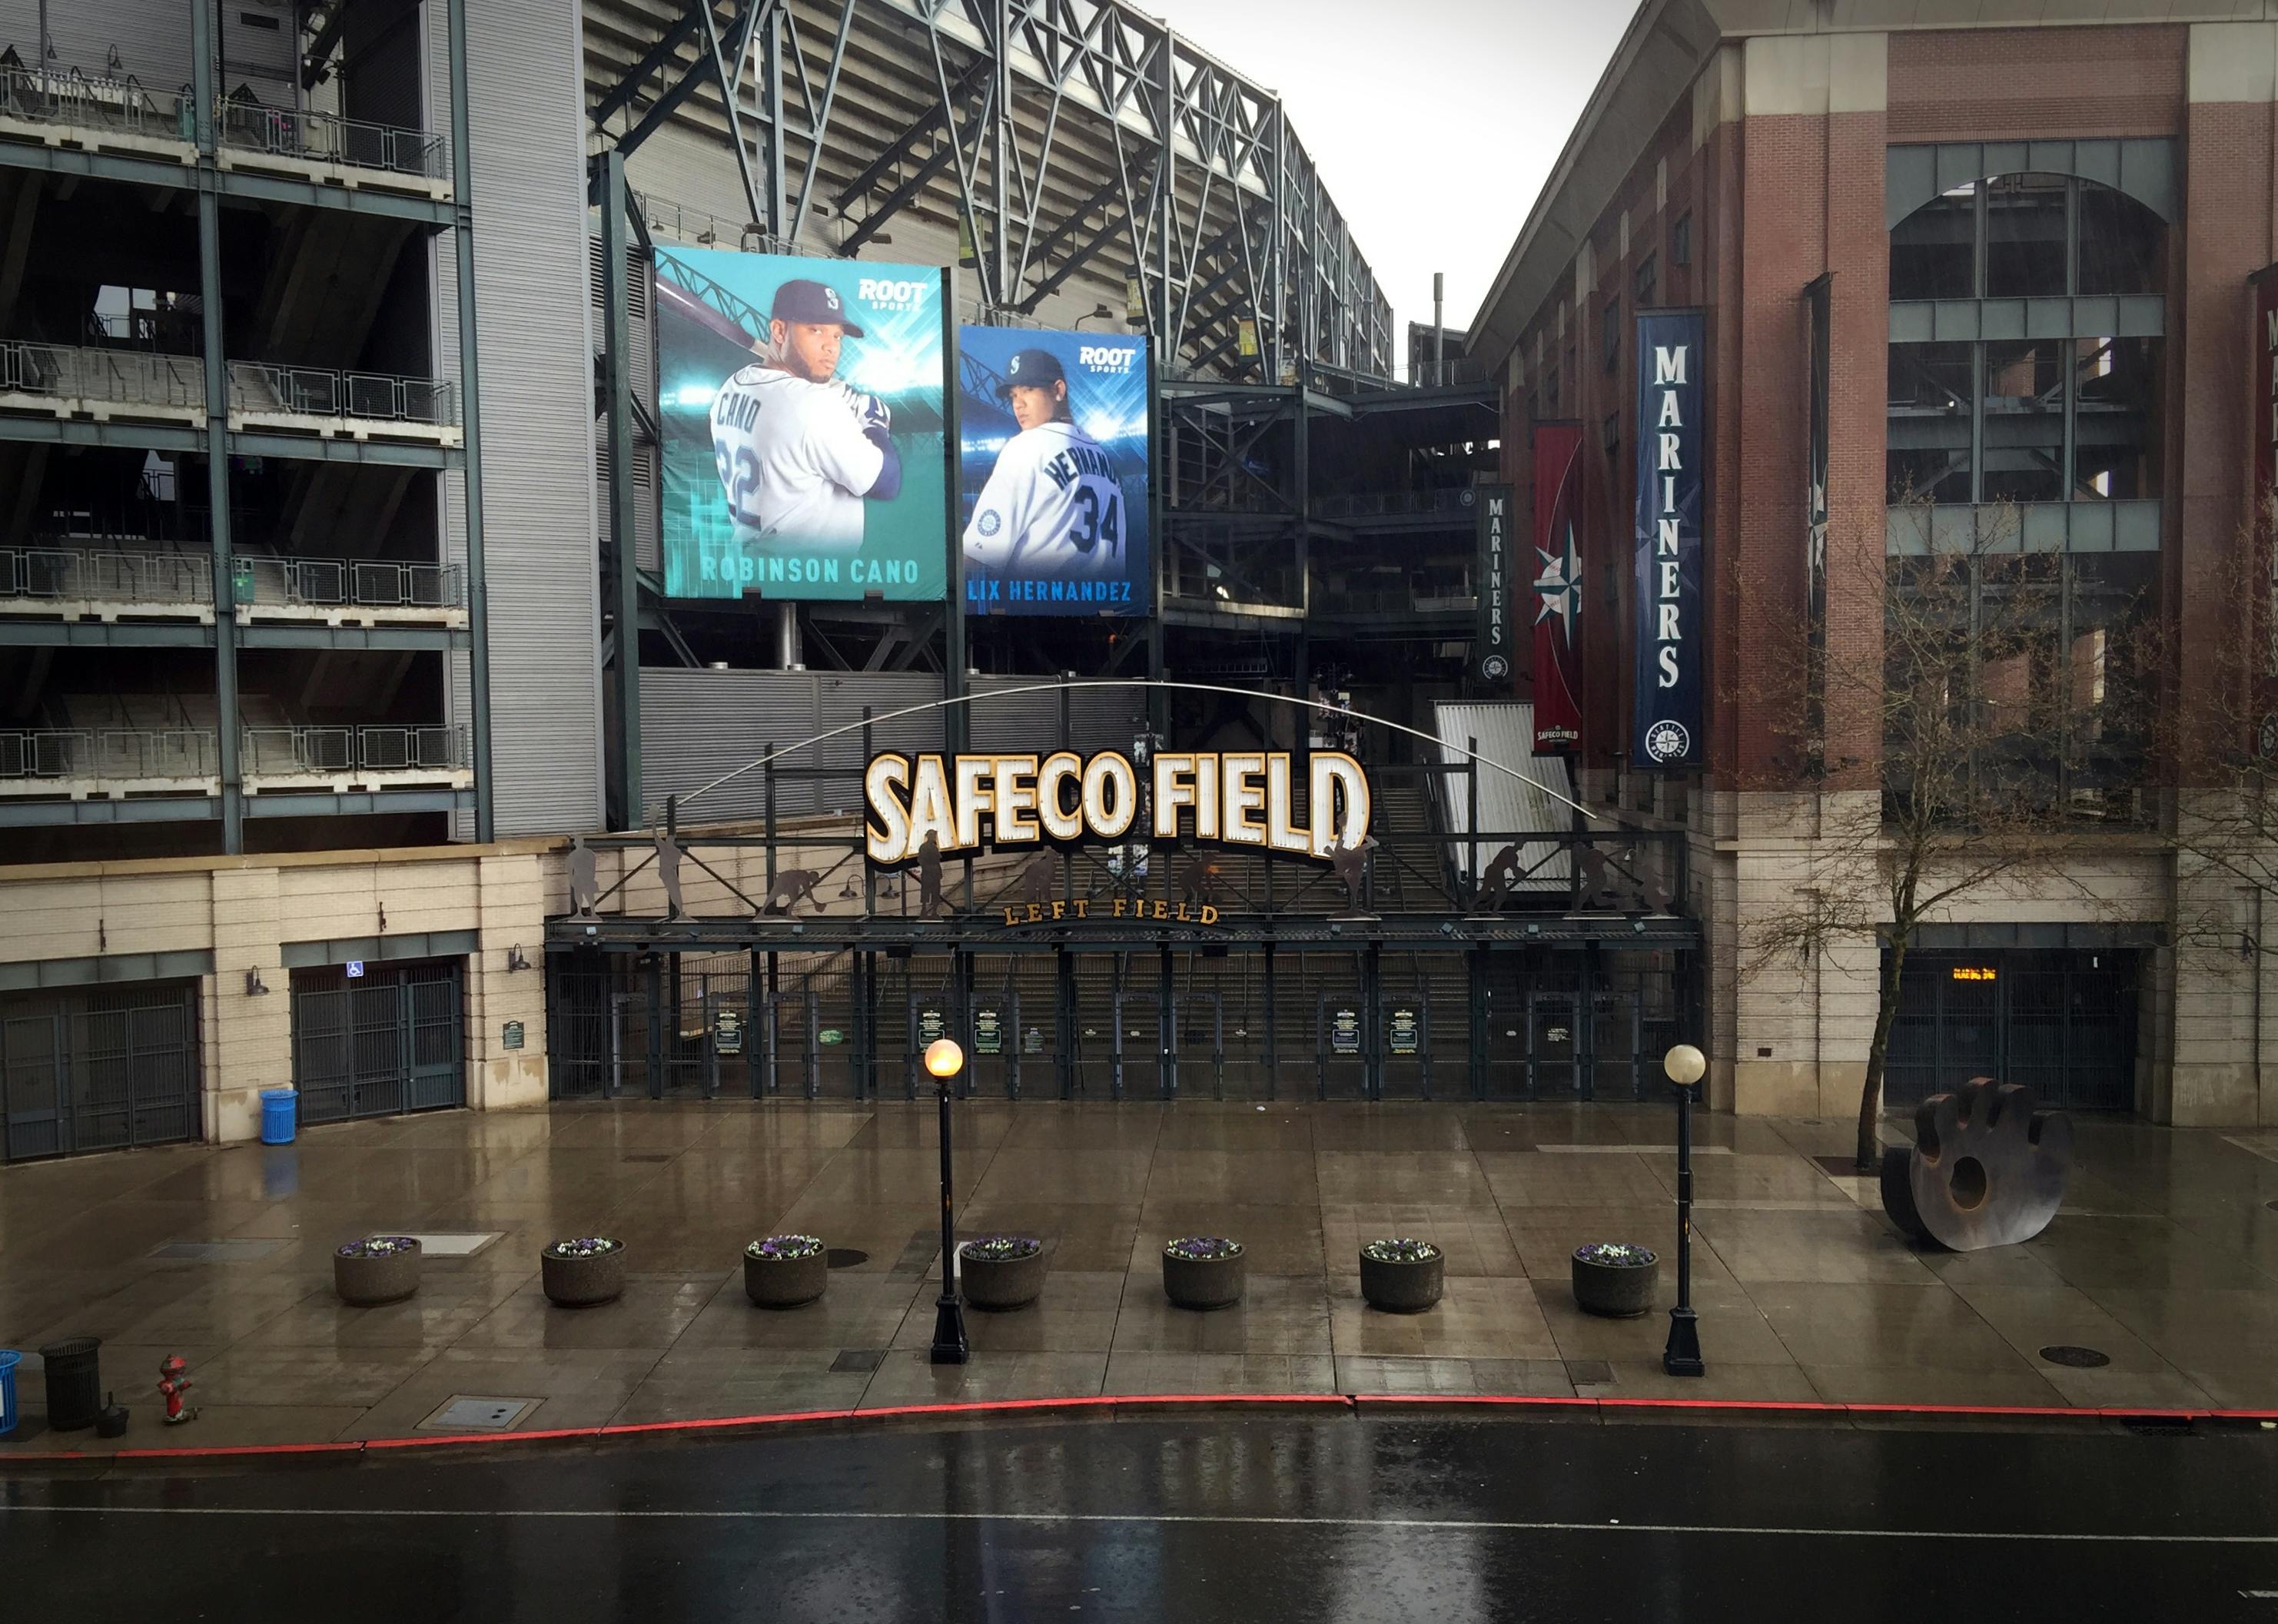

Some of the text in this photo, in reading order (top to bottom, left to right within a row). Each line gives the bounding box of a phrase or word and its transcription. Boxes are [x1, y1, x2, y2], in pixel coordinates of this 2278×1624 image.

[858, 278, 928, 303] ROOT
[1079, 346, 1136, 367] ROOT
[1090, 365, 1130, 374] SPORTS
[716, 392, 762, 433] CANO
[715, 437, 762, 532] 22
[1069, 485, 1118, 559] 34
[1654, 345, 1688, 688] MARINERS
[702, 556, 918, 583] ROBINSON CANO
[1489, 498, 1503, 645] MARINERS
[967, 580, 1132, 602] LIX HERNANDEZ
[1537, 730, 1578, 741] SAFECO FIELD
[865, 750, 1371, 864] SAFECO FIELD
[1004, 898, 1218, 925] LEFT FIELD
